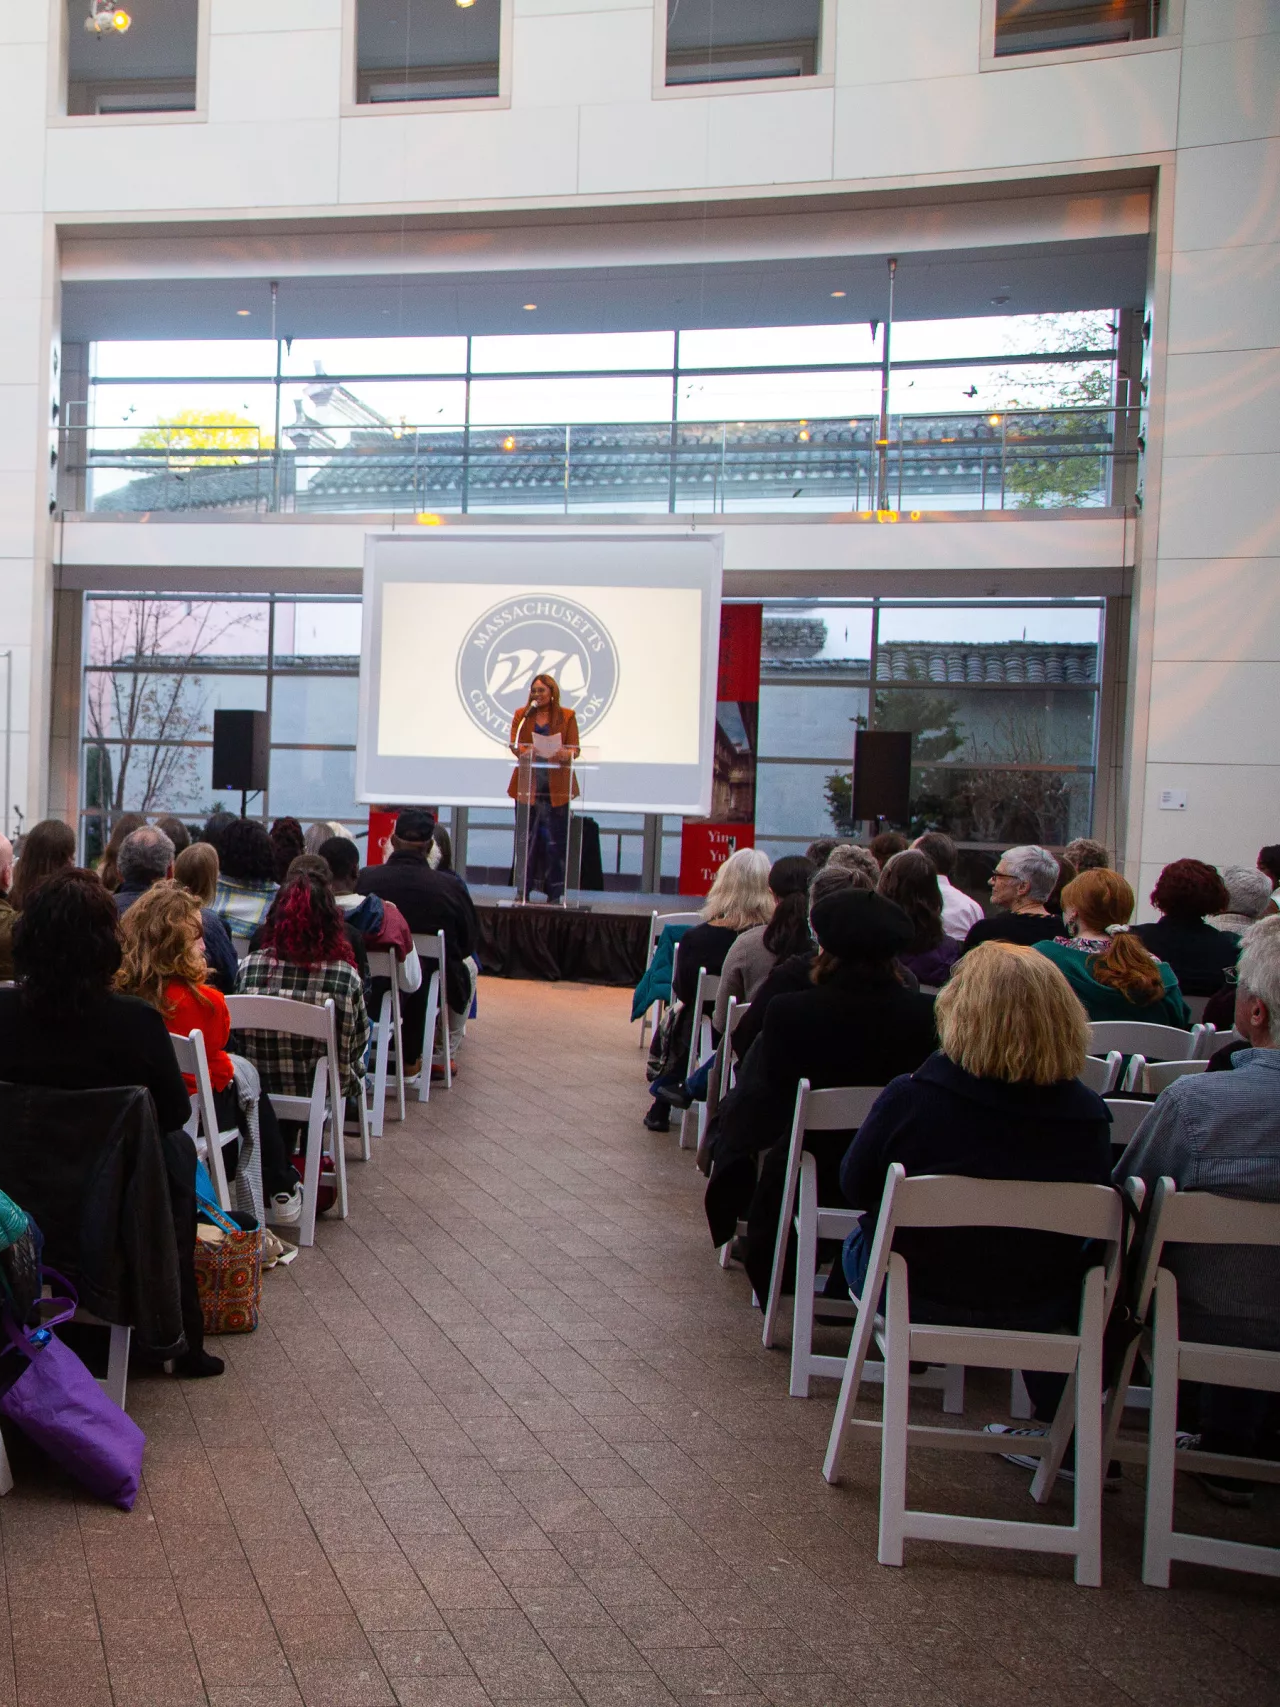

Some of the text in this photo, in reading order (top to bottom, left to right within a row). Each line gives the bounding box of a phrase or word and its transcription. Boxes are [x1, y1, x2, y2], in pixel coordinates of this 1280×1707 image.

[473, 601, 606, 653] MASSACHUSETTS
[470, 689, 605, 735] CENTE OOK
